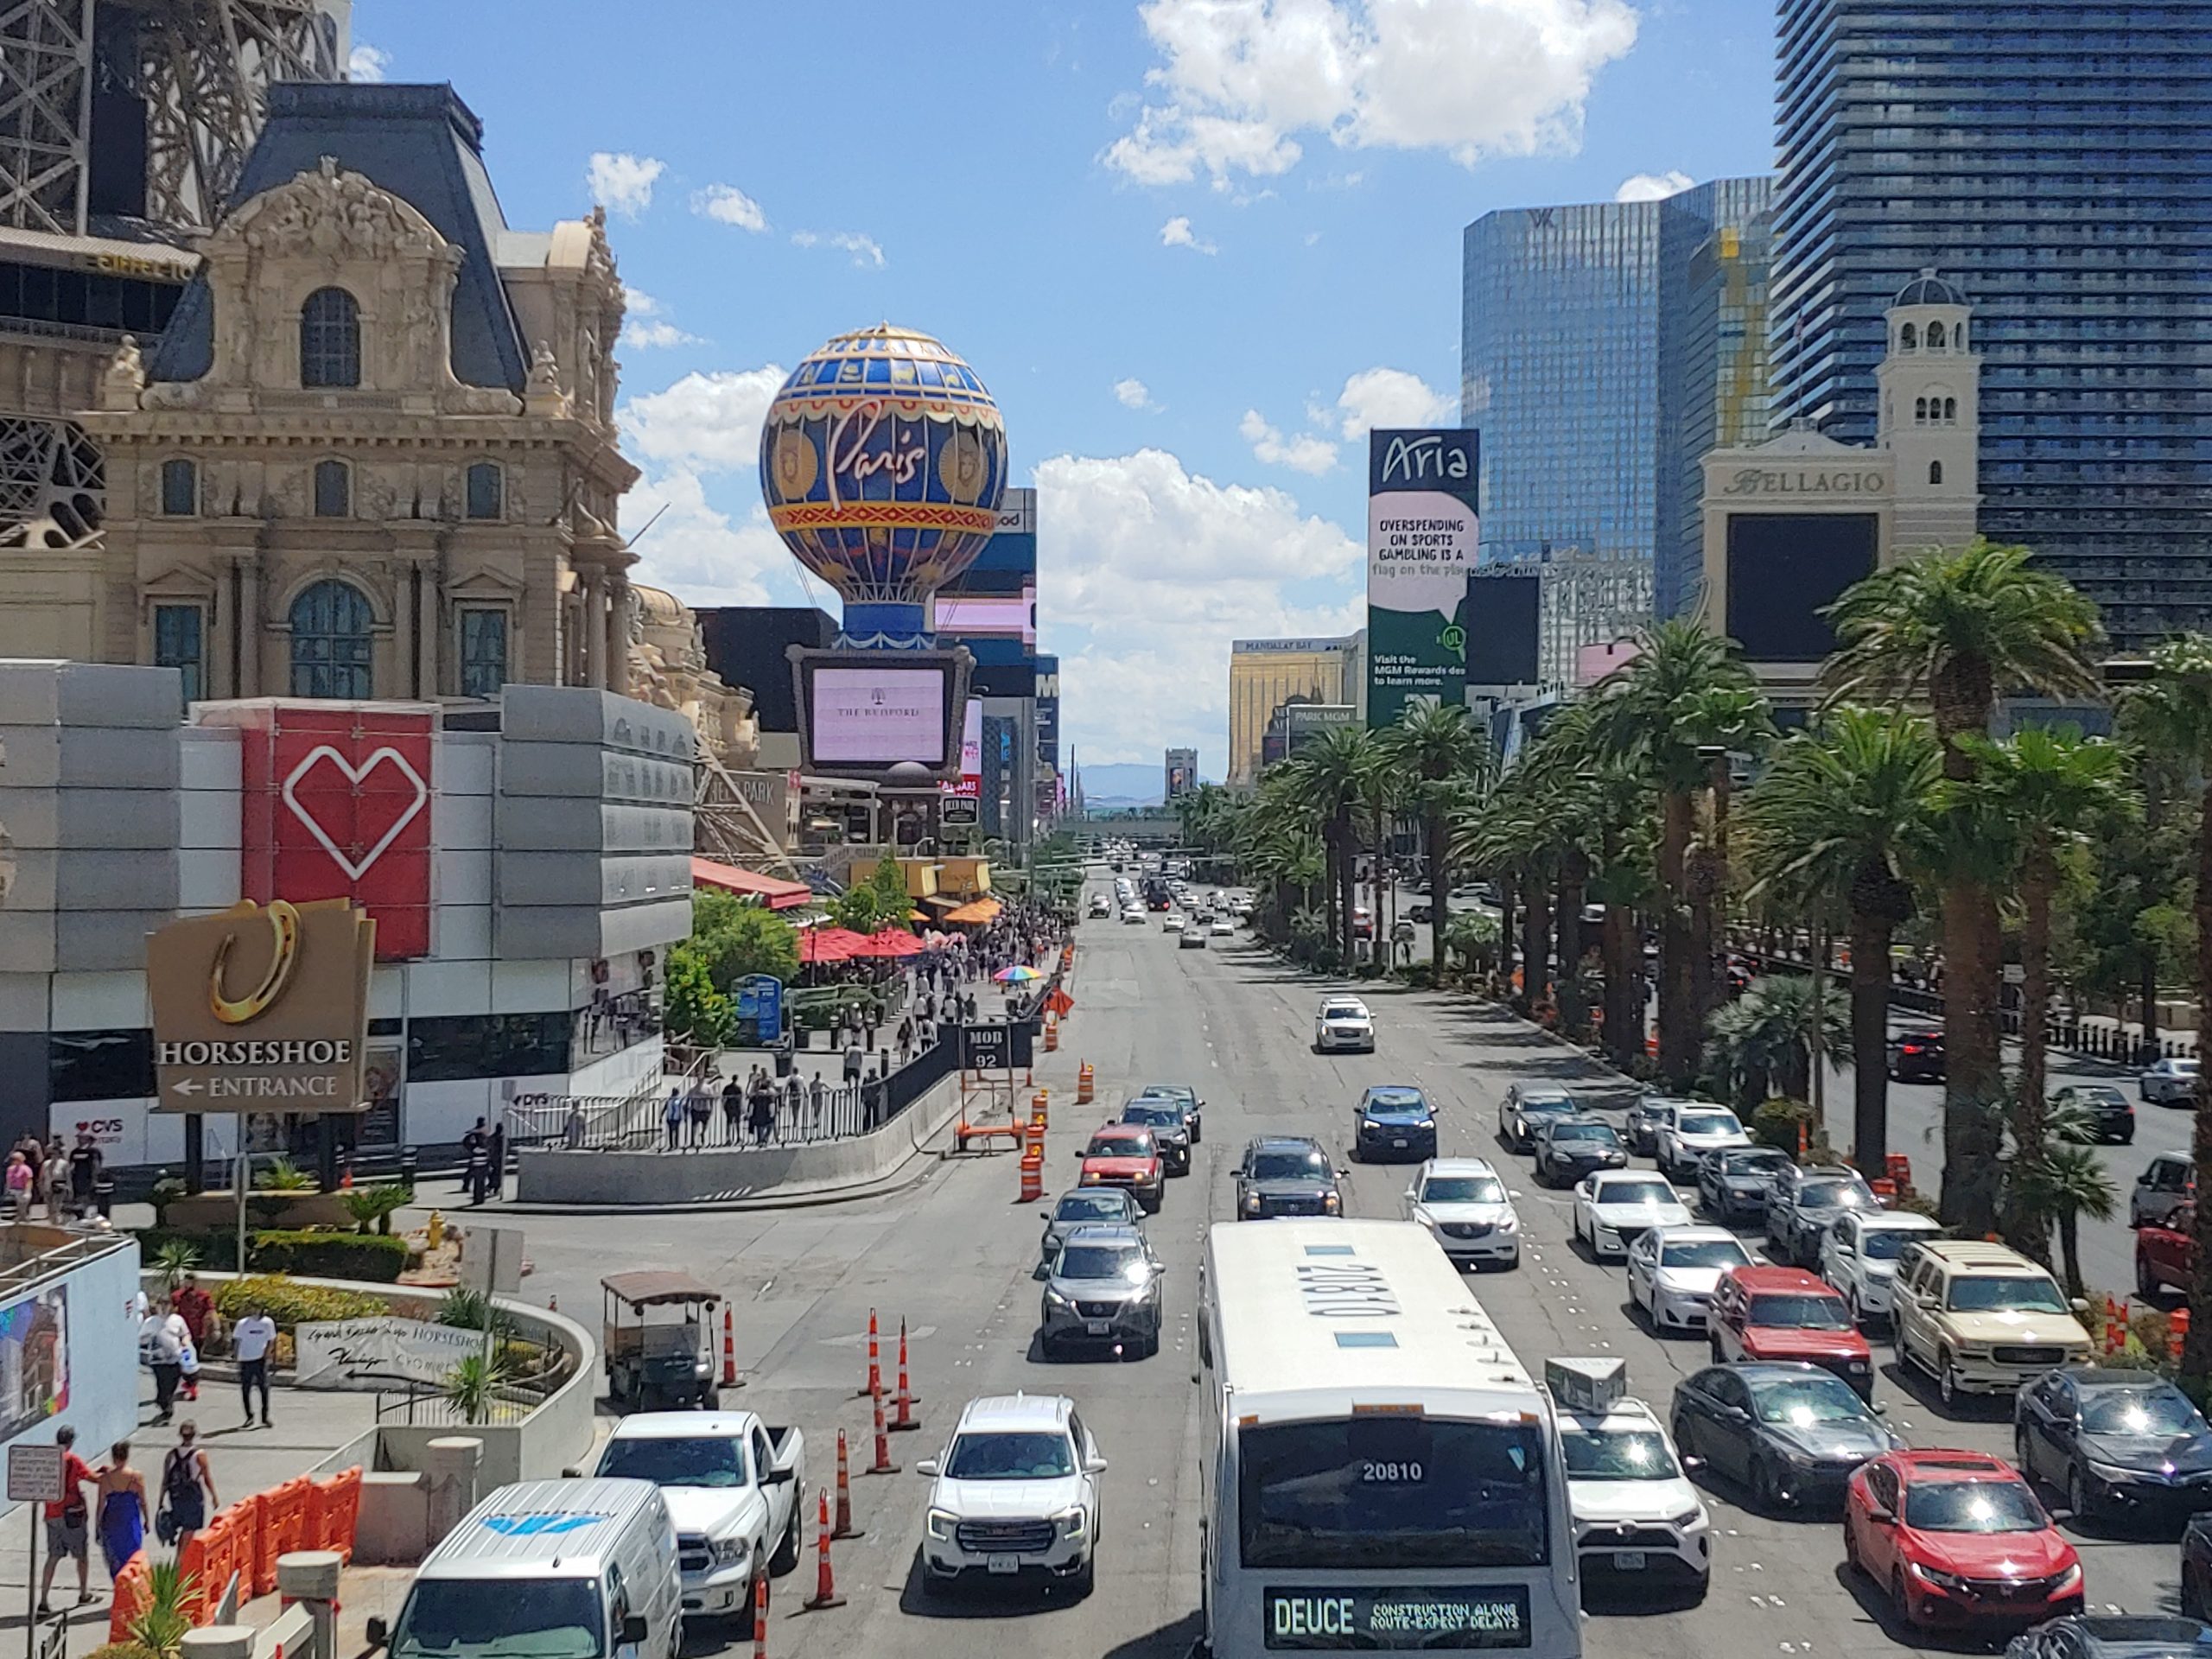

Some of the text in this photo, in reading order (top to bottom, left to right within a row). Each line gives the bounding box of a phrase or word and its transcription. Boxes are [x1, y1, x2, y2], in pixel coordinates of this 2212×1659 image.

[827, 397, 926, 512] Paris
[1382, 435, 1468, 482] Aria
[1723, 469, 1885, 495] BELLAGIO
[1379, 519, 1465, 532] OVERSPENDING
[1390, 534, 1453, 546] ON SPORTS
[1378, 548, 1465, 562] GAMBLING IS A
[1372, 563, 1396, 578] flag
[1400, 566, 1415, 575] on
[1419, 564, 1440, 575] the
[1246, 641, 1313, 651] MANDALAY BAY
[1374, 655, 1417, 664] Visit the
[1374, 665, 1402, 675] MGM
[1404, 665, 1447, 675] Rewards
[1374, 676, 1444, 686] to learn more.
[836, 708, 859, 717] THE
[1295, 711, 1322, 721] PARK
[1324, 710, 1351, 721] MGM
[744, 780, 775, 805] PARK
[969, 1031, 1003, 1044] MOB
[157, 1039, 351, 1065] HORSESHOE
[976, 1054, 996, 1068] 92
[208, 1076, 339, 1097] ENTRANCE
[91, 1118, 124, 1134] CVS
[1296, 1264, 1402, 1318] 20810
[1363, 1462, 1423, 1481] 20810
[1274, 1598, 1517, 1635] DEUCE CONSTRUCTION ALONG
[1370, 1615, 1520, 1630] ROUTE-EXPECT DELAYS
